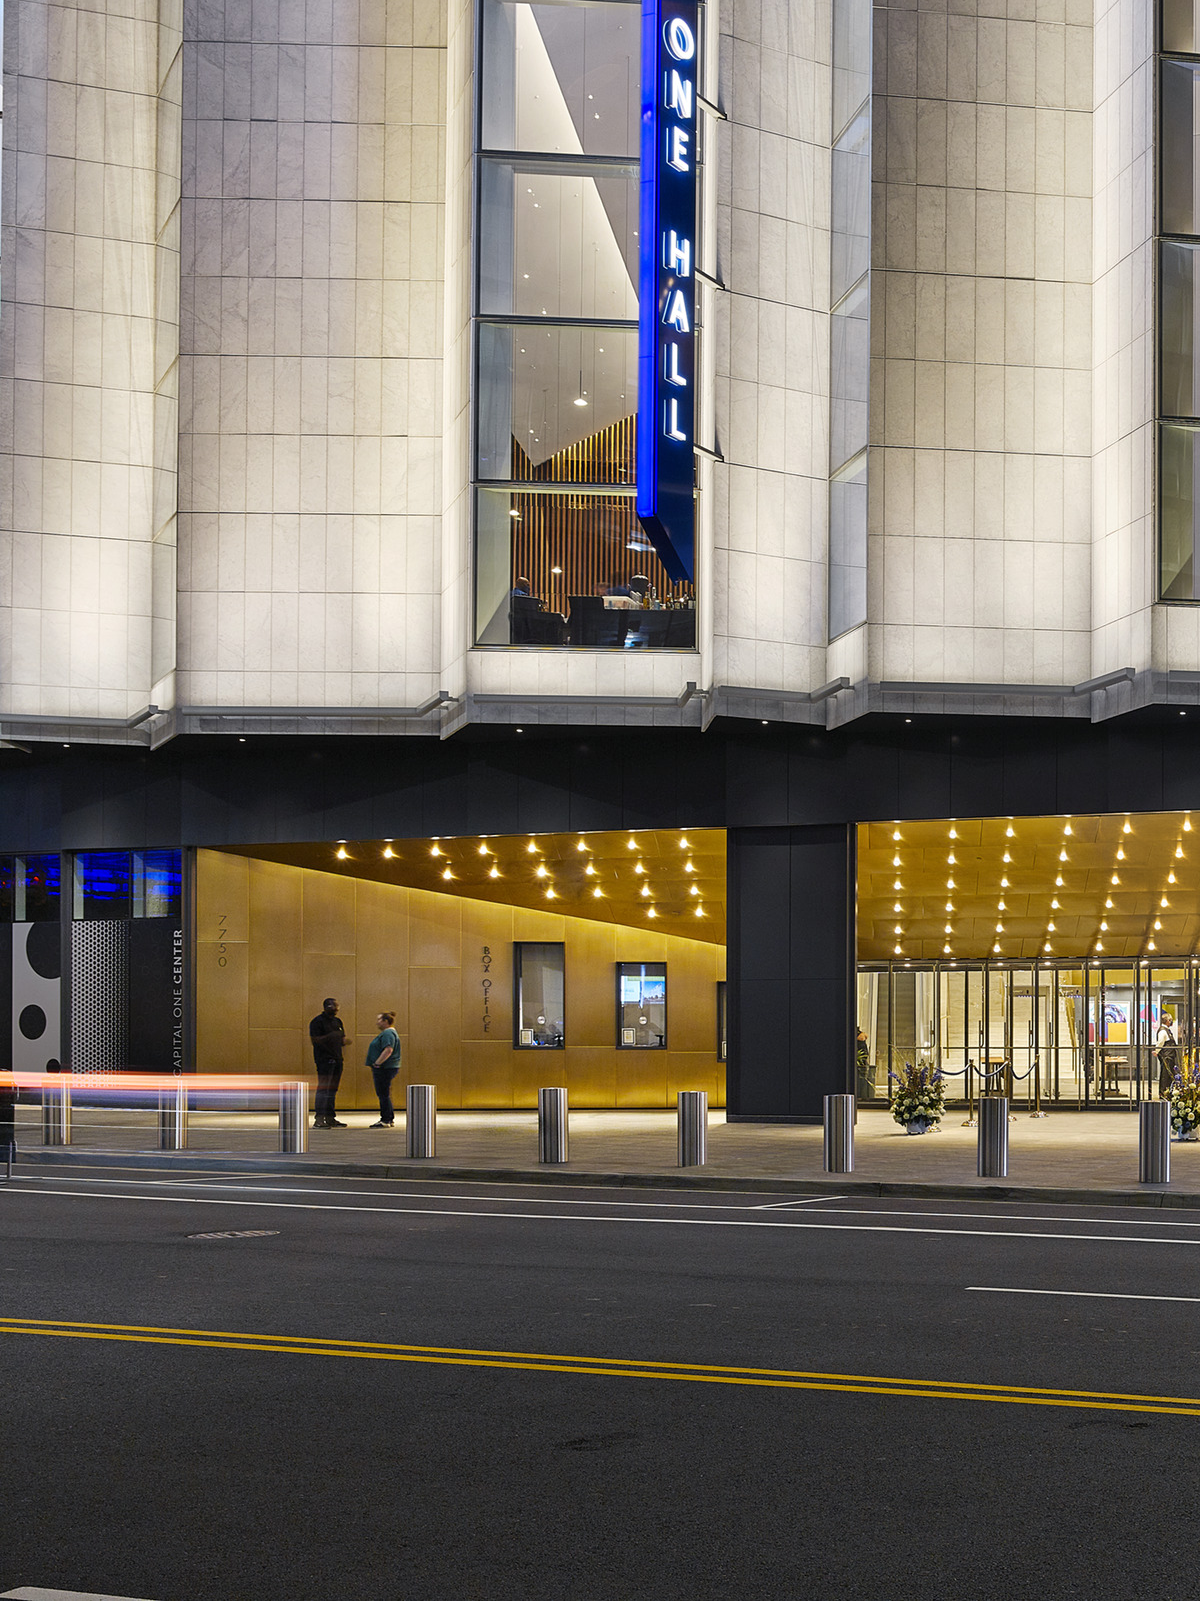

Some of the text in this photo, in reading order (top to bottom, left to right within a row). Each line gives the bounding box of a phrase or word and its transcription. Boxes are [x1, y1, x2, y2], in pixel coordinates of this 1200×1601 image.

[662, 17, 695, 173] ONE
[662, 228, 692, 443] HALL
[173, 929, 183, 1079] CAPITAL ONE CENTER
[218, 915, 228, 968] 7750
[482, 946, 492, 1033] BOX OFFICE
